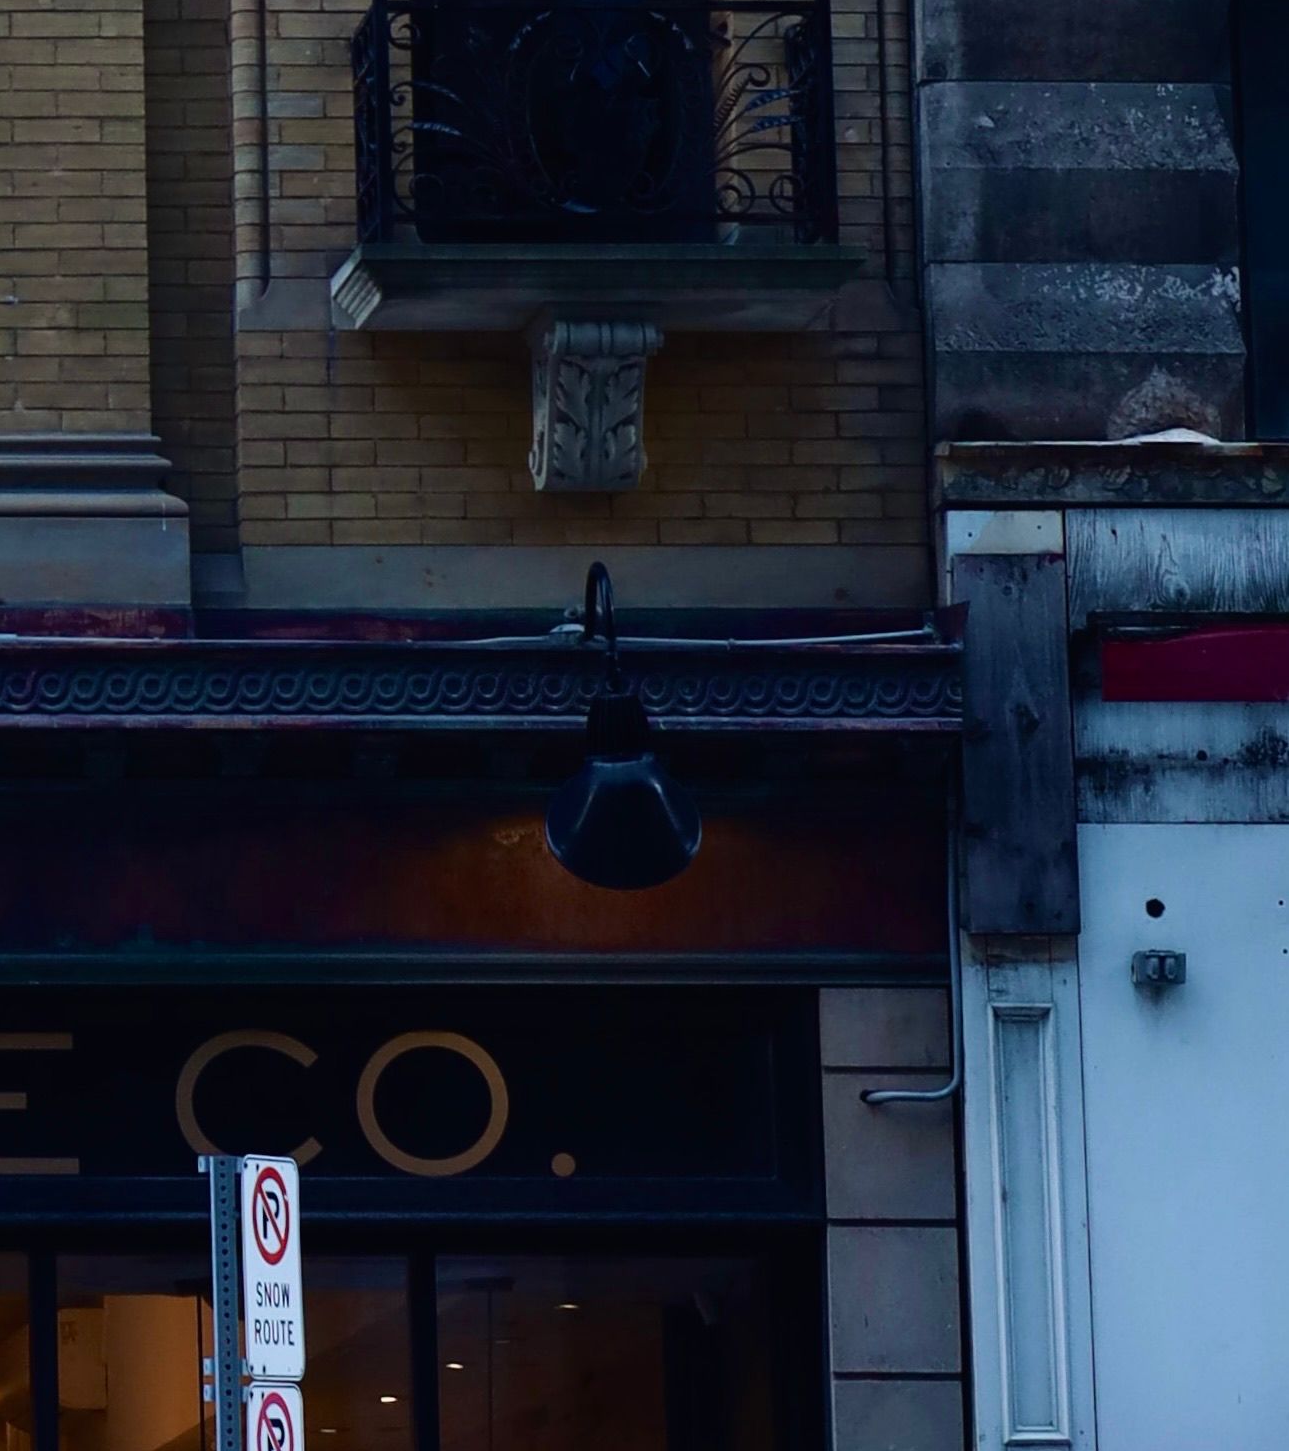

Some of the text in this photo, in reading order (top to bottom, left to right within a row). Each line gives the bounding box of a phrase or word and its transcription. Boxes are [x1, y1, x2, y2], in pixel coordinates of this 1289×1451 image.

[175, 1029, 578, 1179] CO.
[256, 1282, 290, 1308] SNOW
[254, 1319, 295, 1346] ROUTE
